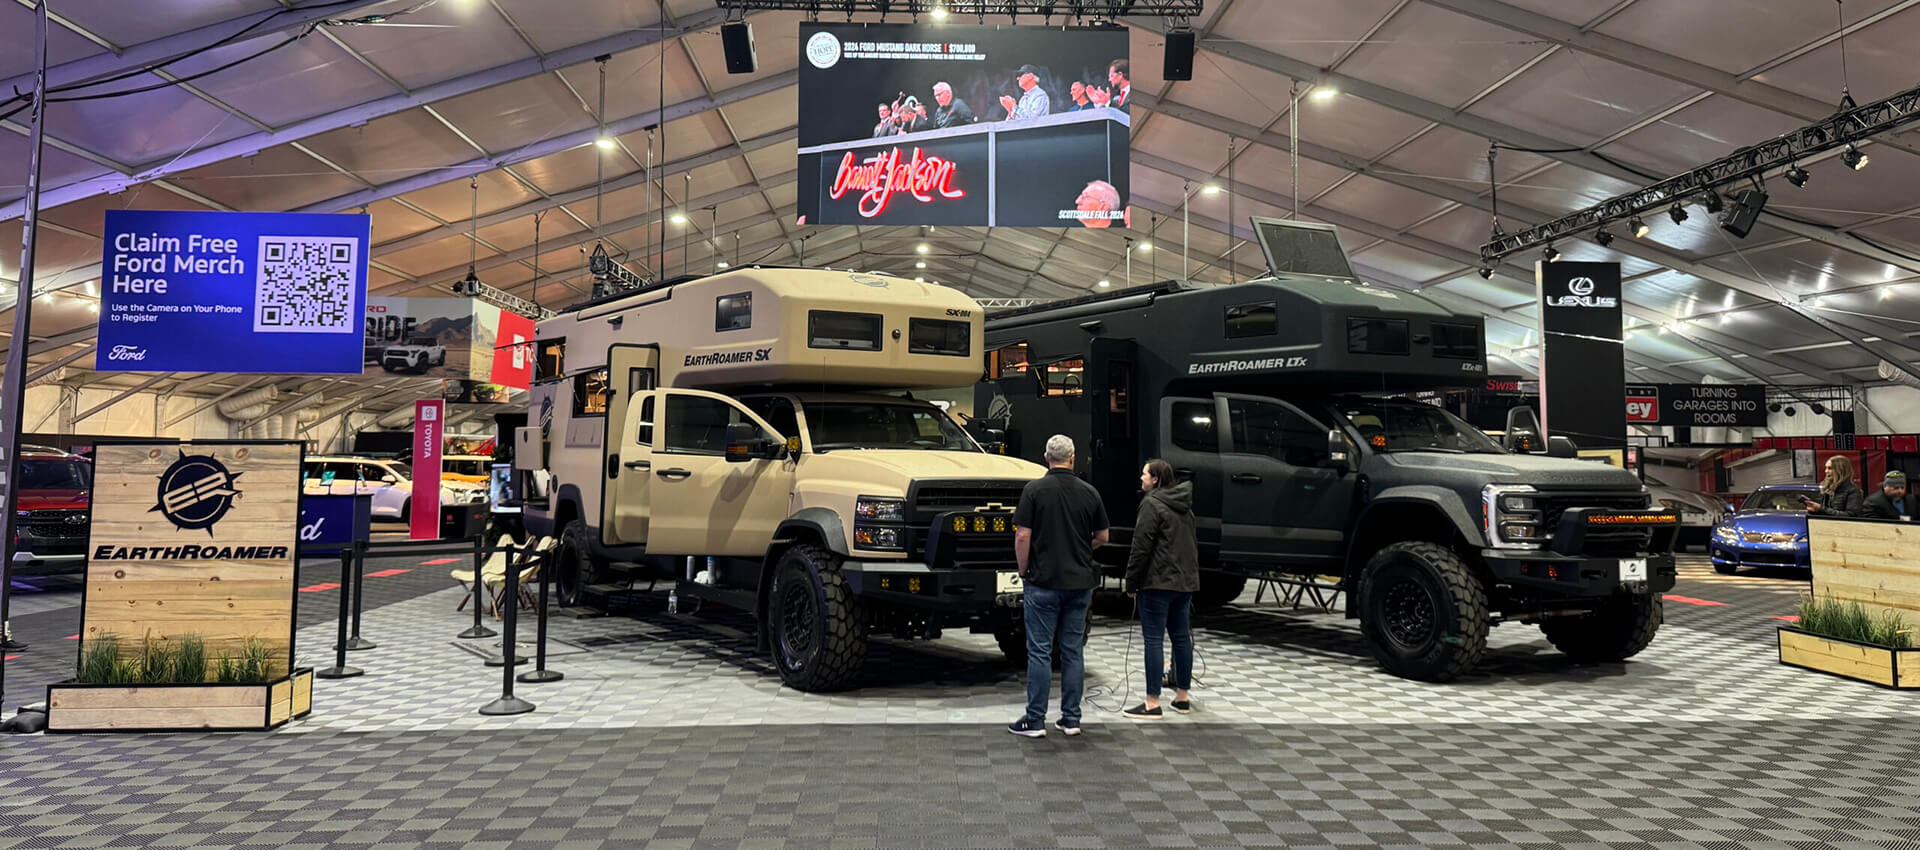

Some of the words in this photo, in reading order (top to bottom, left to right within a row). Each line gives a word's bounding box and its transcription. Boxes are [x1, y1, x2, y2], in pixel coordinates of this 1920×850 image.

[859, 42, 876, 52] FORD
[876, 42, 905, 53] MUSTANG
[905, 43, 921, 53] DARK
[922, 43, 942, 53] HORSE
[1058, 210, 1095, 220] SCOTTSDALE
[1095, 210, 1109, 220] FALL
[114, 232, 180, 252] Claim
[188, 234, 238, 253] Free
[114, 253, 166, 273] Ford
[174, 254, 245, 274] Merch
[112, 274, 168, 294] Here
[1547, 295, 1618, 308] LEXUS
[111, 303, 129, 312] Use
[130, 303, 145, 312] the
[146, 303, 179, 313] Camera
[180, 305, 192, 313] on
[193, 304, 213, 313] Your
[214, 304, 243, 313] Phone
[111, 313, 121, 322] to
[122, 313, 158, 323] Register
[108, 344, 147, 361] Ford
[754, 347, 772, 361] SX
[1690, 387, 1737, 398] TURNING
[1673, 400, 1729, 411] GARAGES
[1731, 400, 1757, 411] INTO
[1694, 413, 1736, 423] ROOMS
[423, 423, 432, 458] TOYOTA
